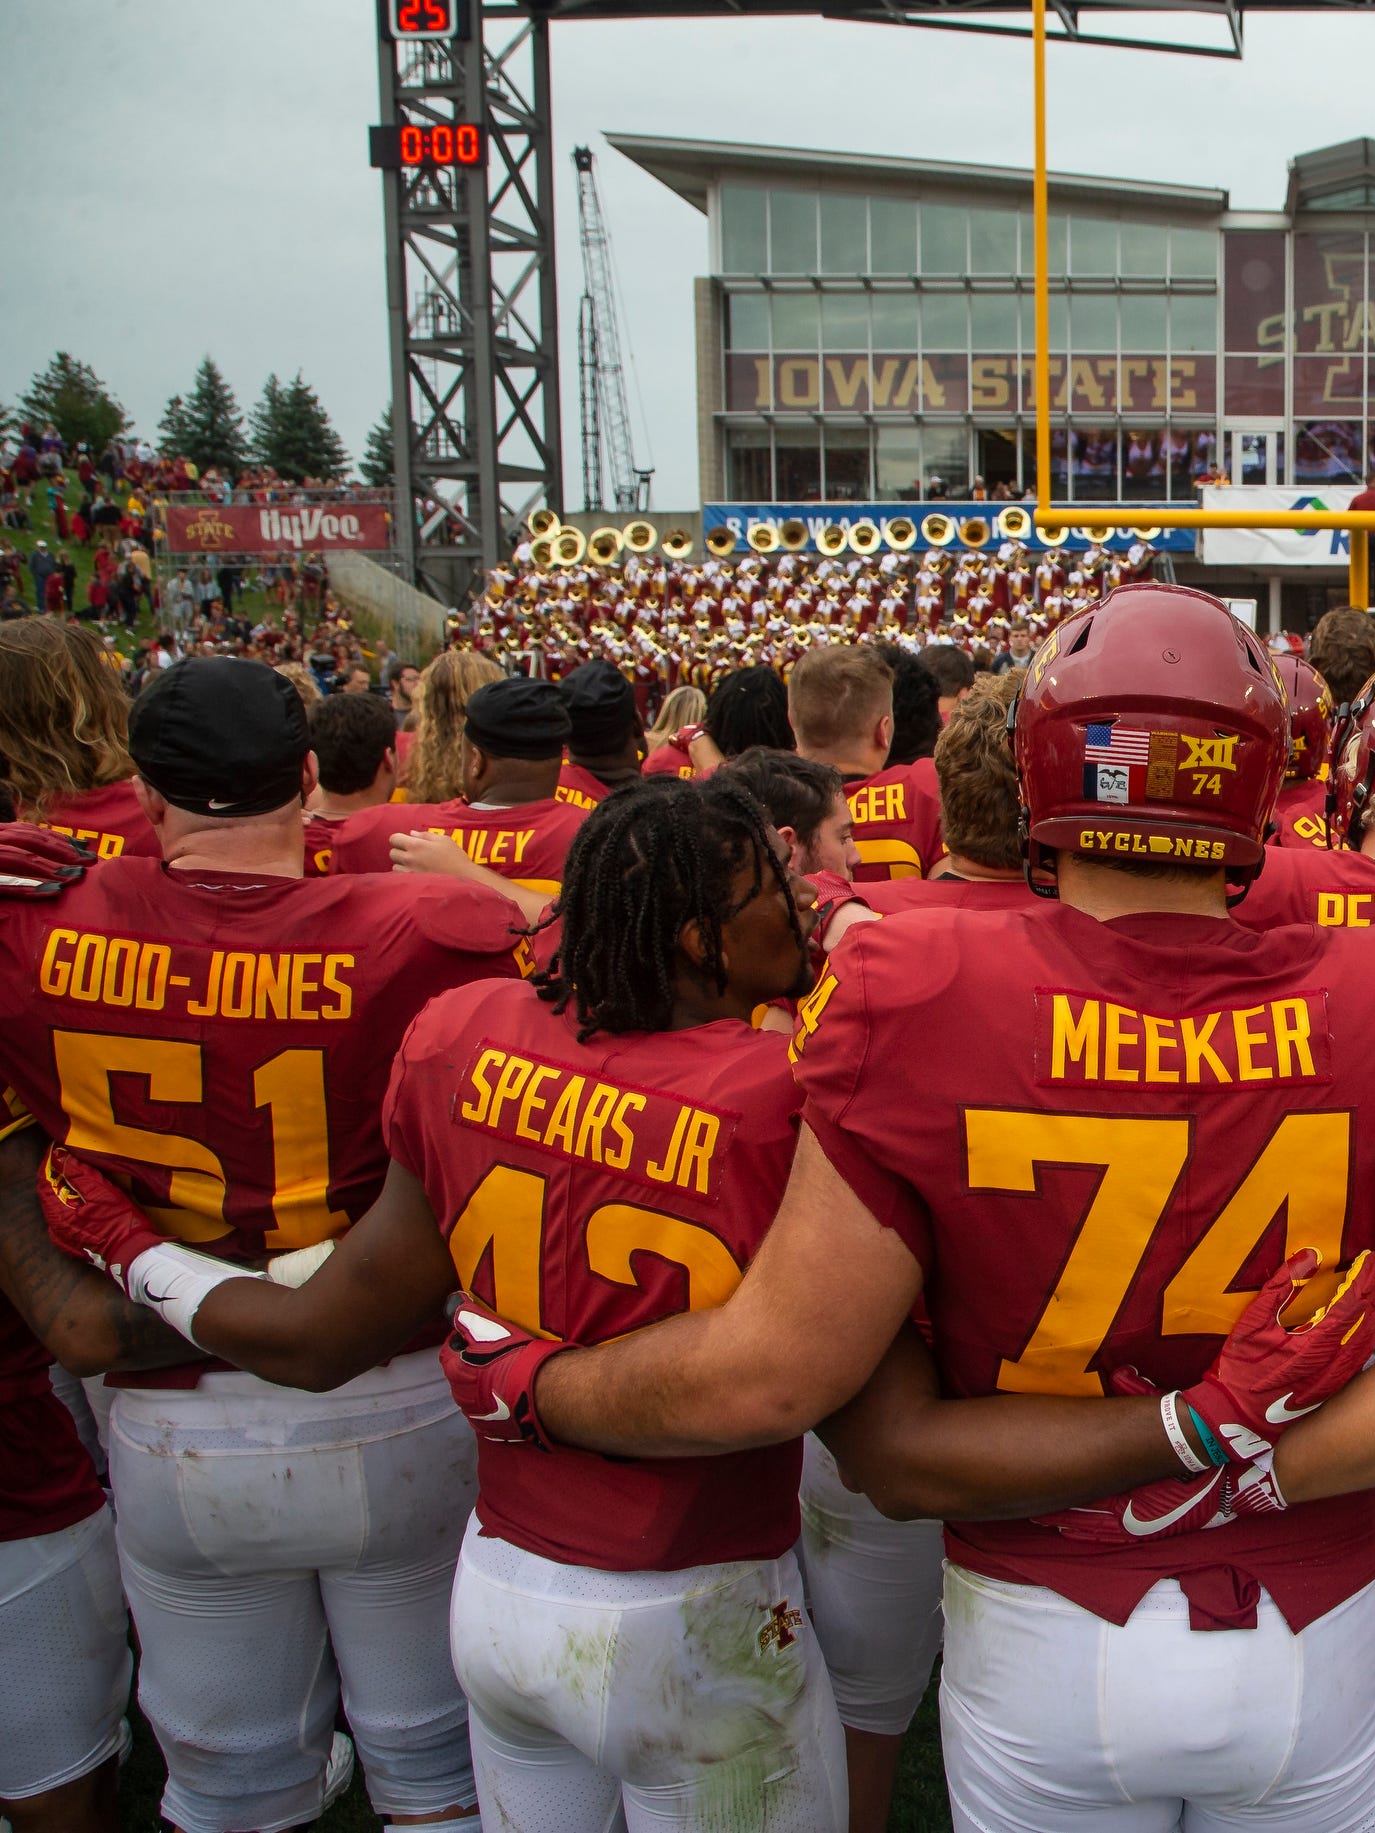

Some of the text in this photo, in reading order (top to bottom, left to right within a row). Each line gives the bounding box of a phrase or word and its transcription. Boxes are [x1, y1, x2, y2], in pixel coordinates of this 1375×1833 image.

[399, 0, 446, 31] 25
[401, 124, 479, 164] 0:00
[753, 358, 1197, 409] IOWA STATE
[1178, 734, 1239, 772] XII
[1192, 774, 1222, 795] 74
[428, 827, 535, 864] AILEY
[40, 928, 355, 1020] GOOD-JONES
[1051, 994, 1317, 1084] MEEKER
[51, 1028, 354, 1250] 51
[461, 1048, 721, 1195] SPEARS JR
[964, 1108, 1351, 1398] 74
